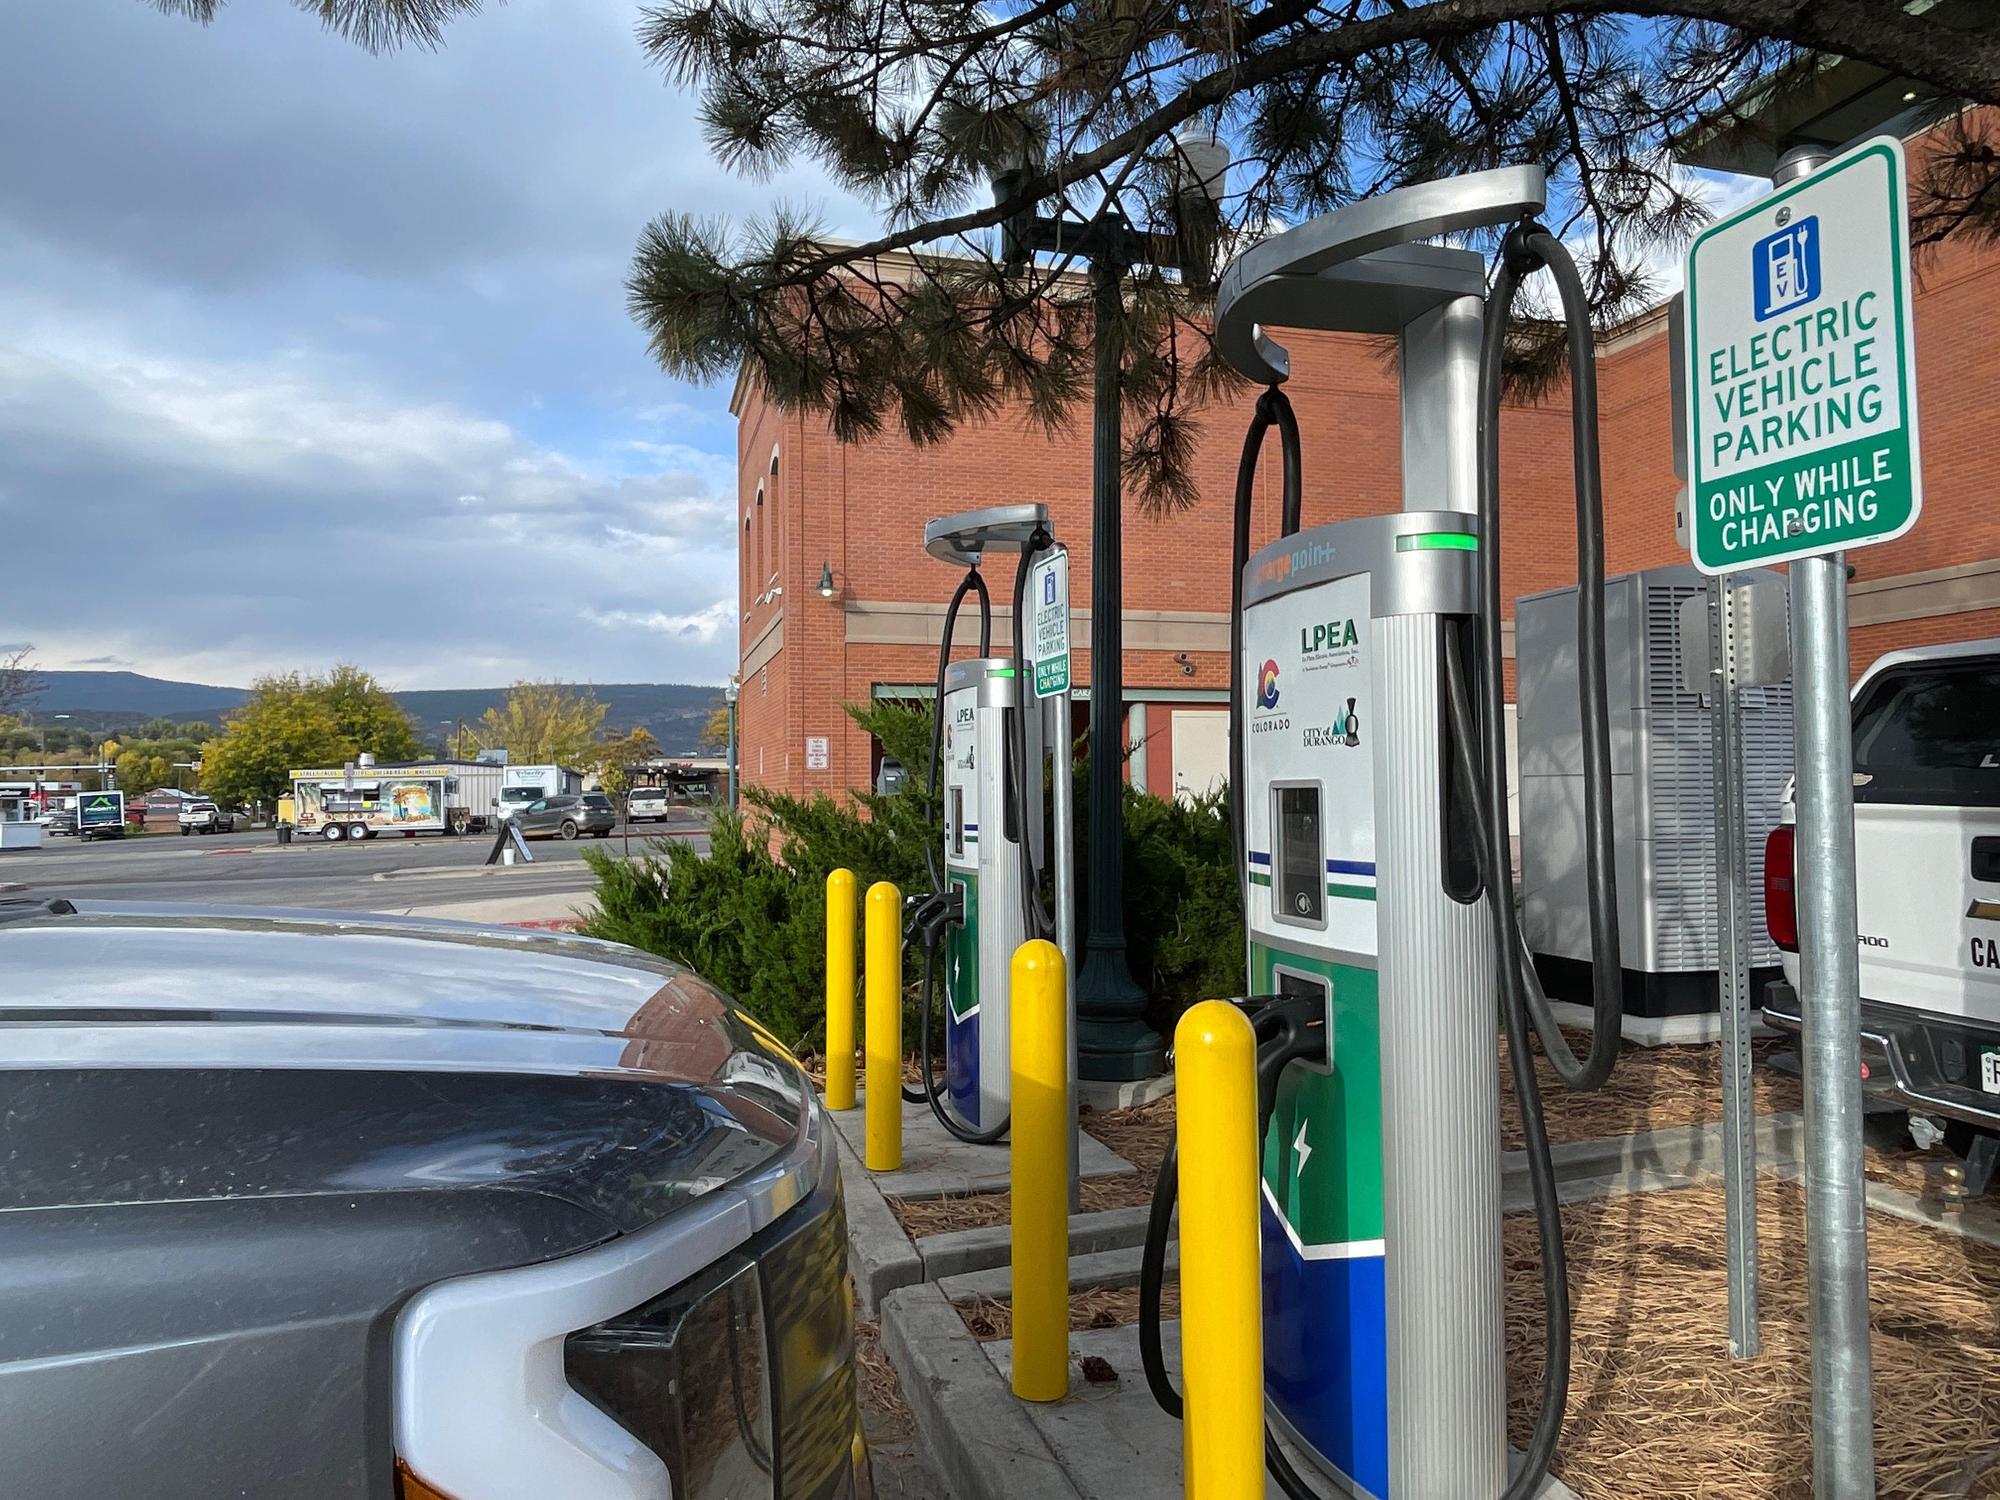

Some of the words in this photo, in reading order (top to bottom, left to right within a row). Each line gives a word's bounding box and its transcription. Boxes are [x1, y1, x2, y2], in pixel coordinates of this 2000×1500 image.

[1710, 291, 1878, 386] ELECTRIC
[1714, 337, 1878, 423] VEHICLE
[1713, 384, 1882, 467] PARKING
[1710, 476, 1785, 521] ONLY
[1794, 448, 1892, 501] WHILE
[1722, 489, 1878, 551] CHARGING
[1037, 603, 1064, 626] ELECTRIC
[1038, 620, 1065, 642] VEHICLE
[1301, 619, 1358, 654] LPEA
[1037, 636, 1065, 657] PARKING
[1037, 663, 1051, 677] ONLY
[1051, 659, 1067, 674] WHILE
[957, 708, 974, 723] LPEA
[1252, 719, 1290, 733] COLORADO
[1303, 727, 1322, 738] CITY
[1323, 726, 1331, 736] of
[1303, 735, 1346, 747] DURANGO
